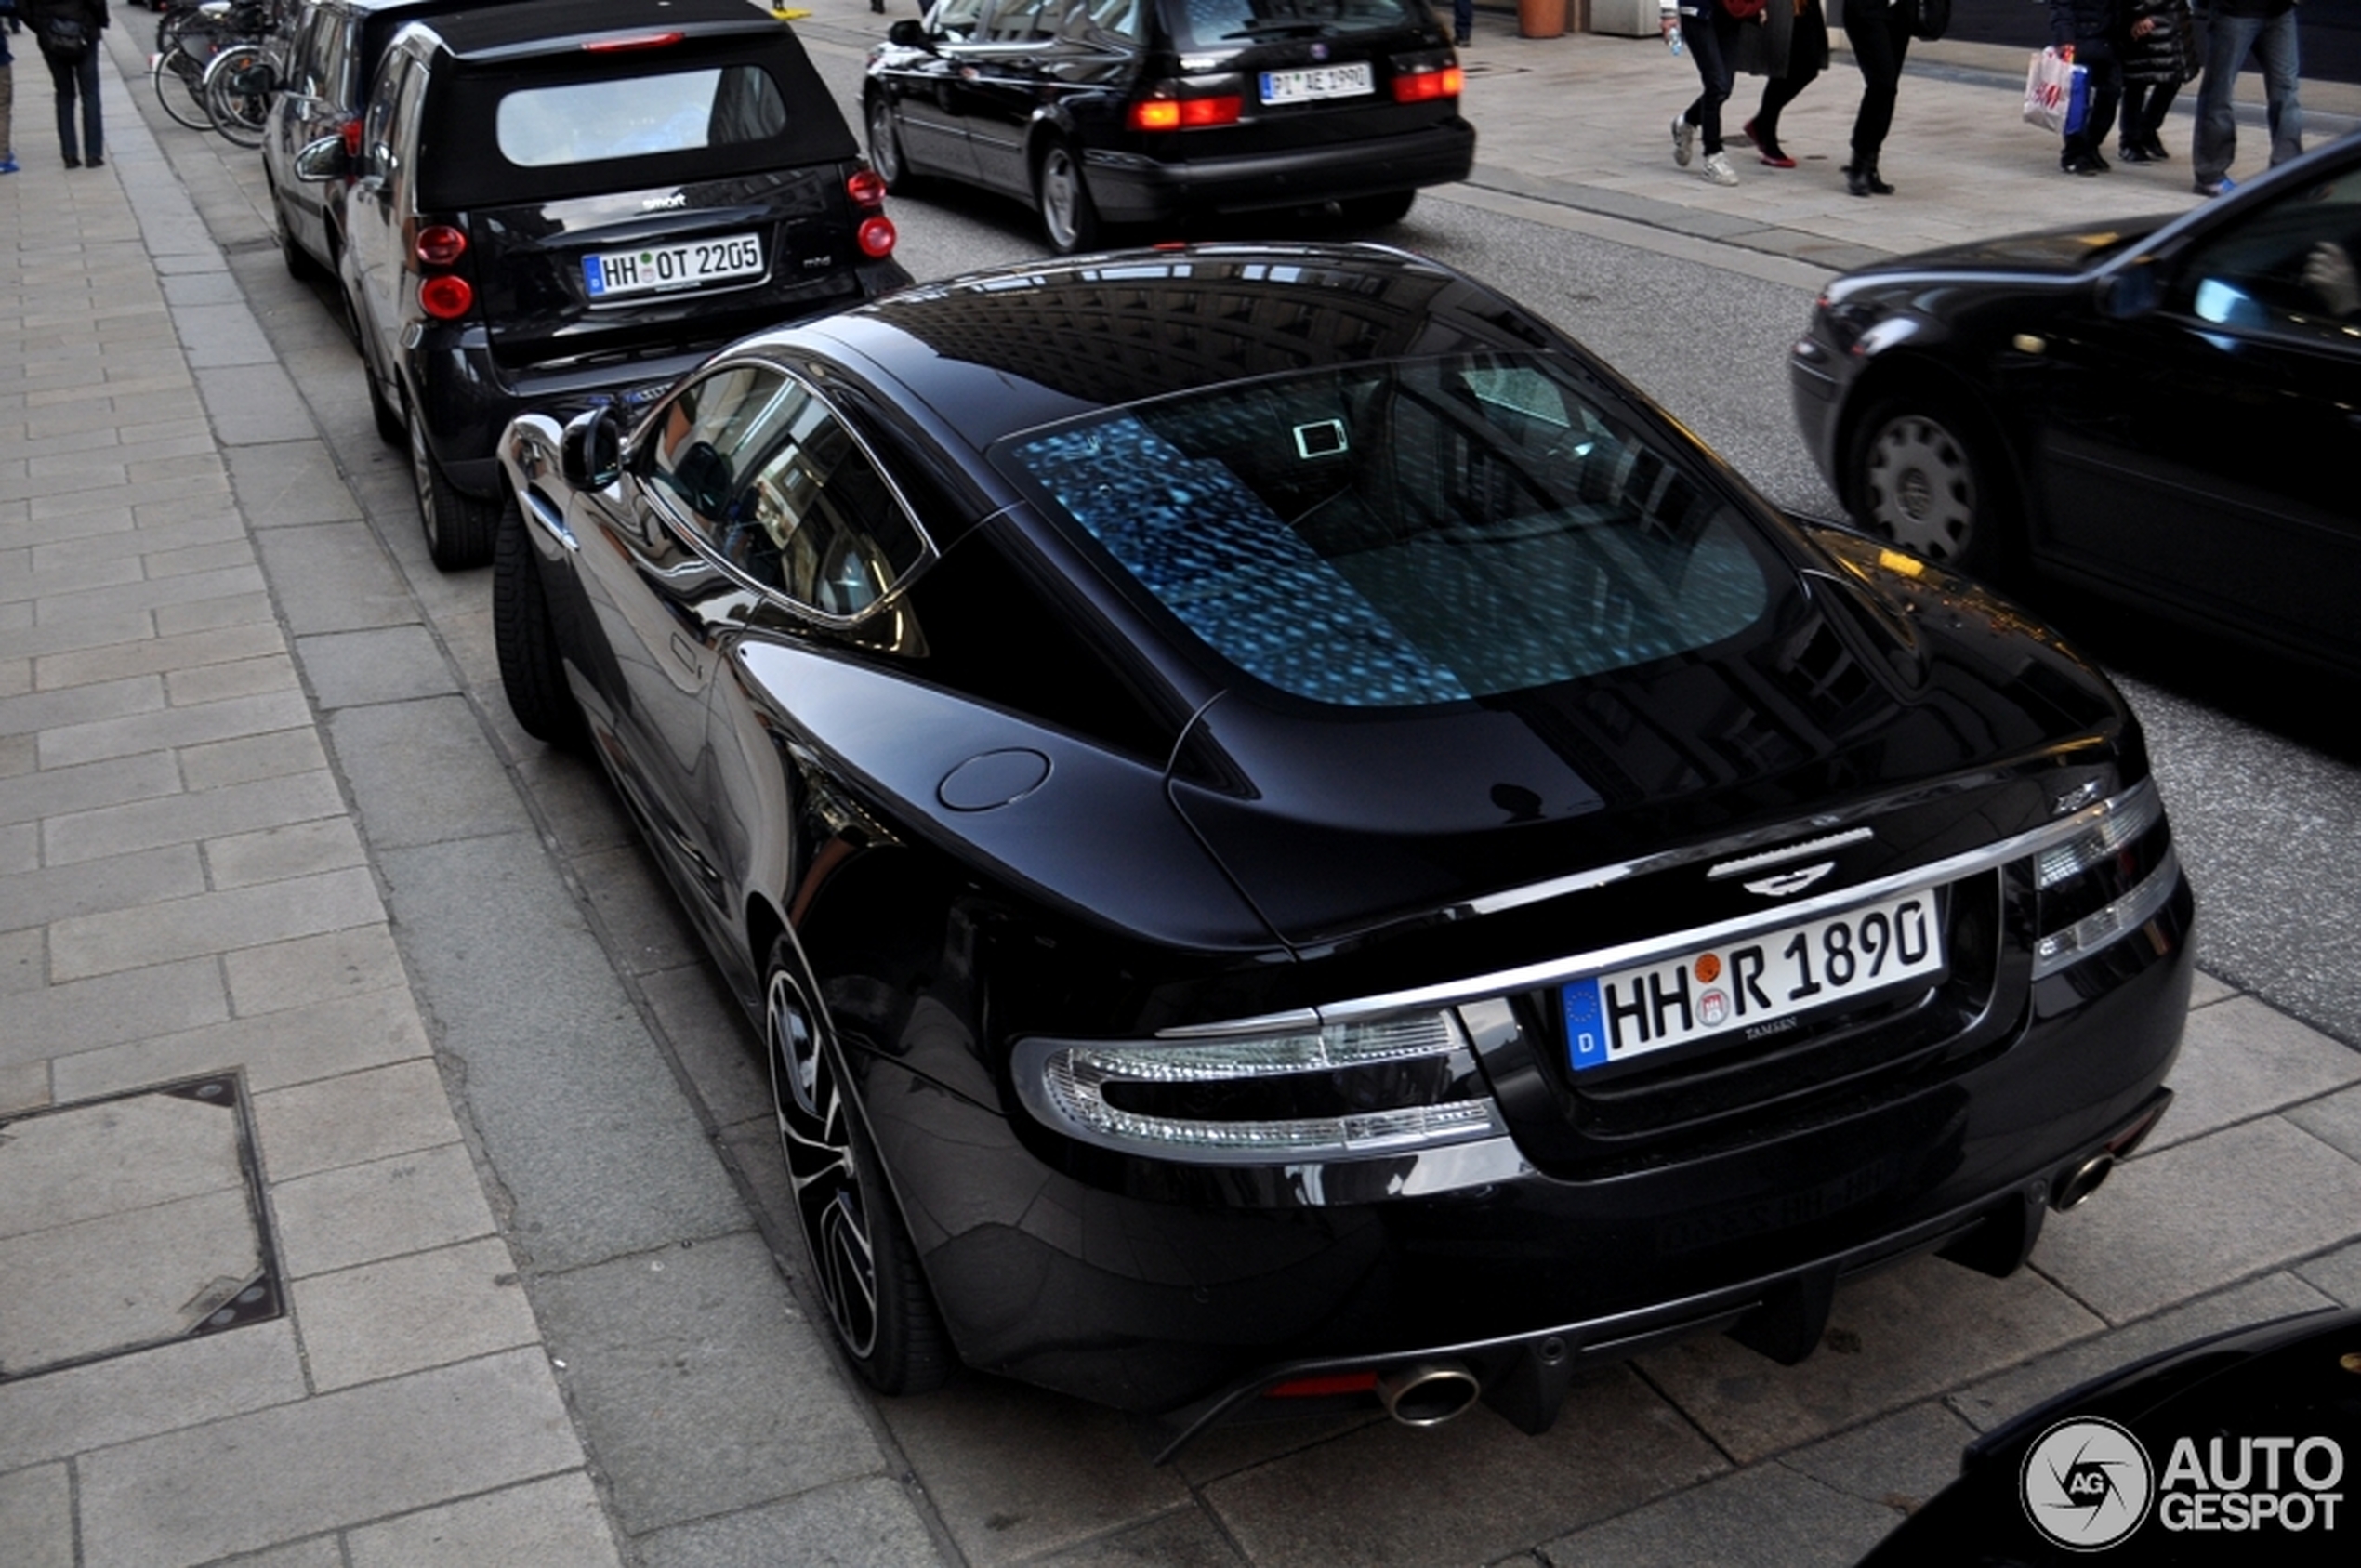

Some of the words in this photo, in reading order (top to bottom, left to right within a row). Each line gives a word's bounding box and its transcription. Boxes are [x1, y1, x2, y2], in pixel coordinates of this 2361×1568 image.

[642, 193, 686, 211] smart
[603, 257, 638, 286] HH
[656, 249, 687, 280] OT
[696, 239, 758, 275] 2205
[1578, 1033, 1594, 1052] D
[1604, 965, 1694, 1050] HH
[1729, 945, 1772, 1016] R
[1784, 900, 1929, 1001] 1890
